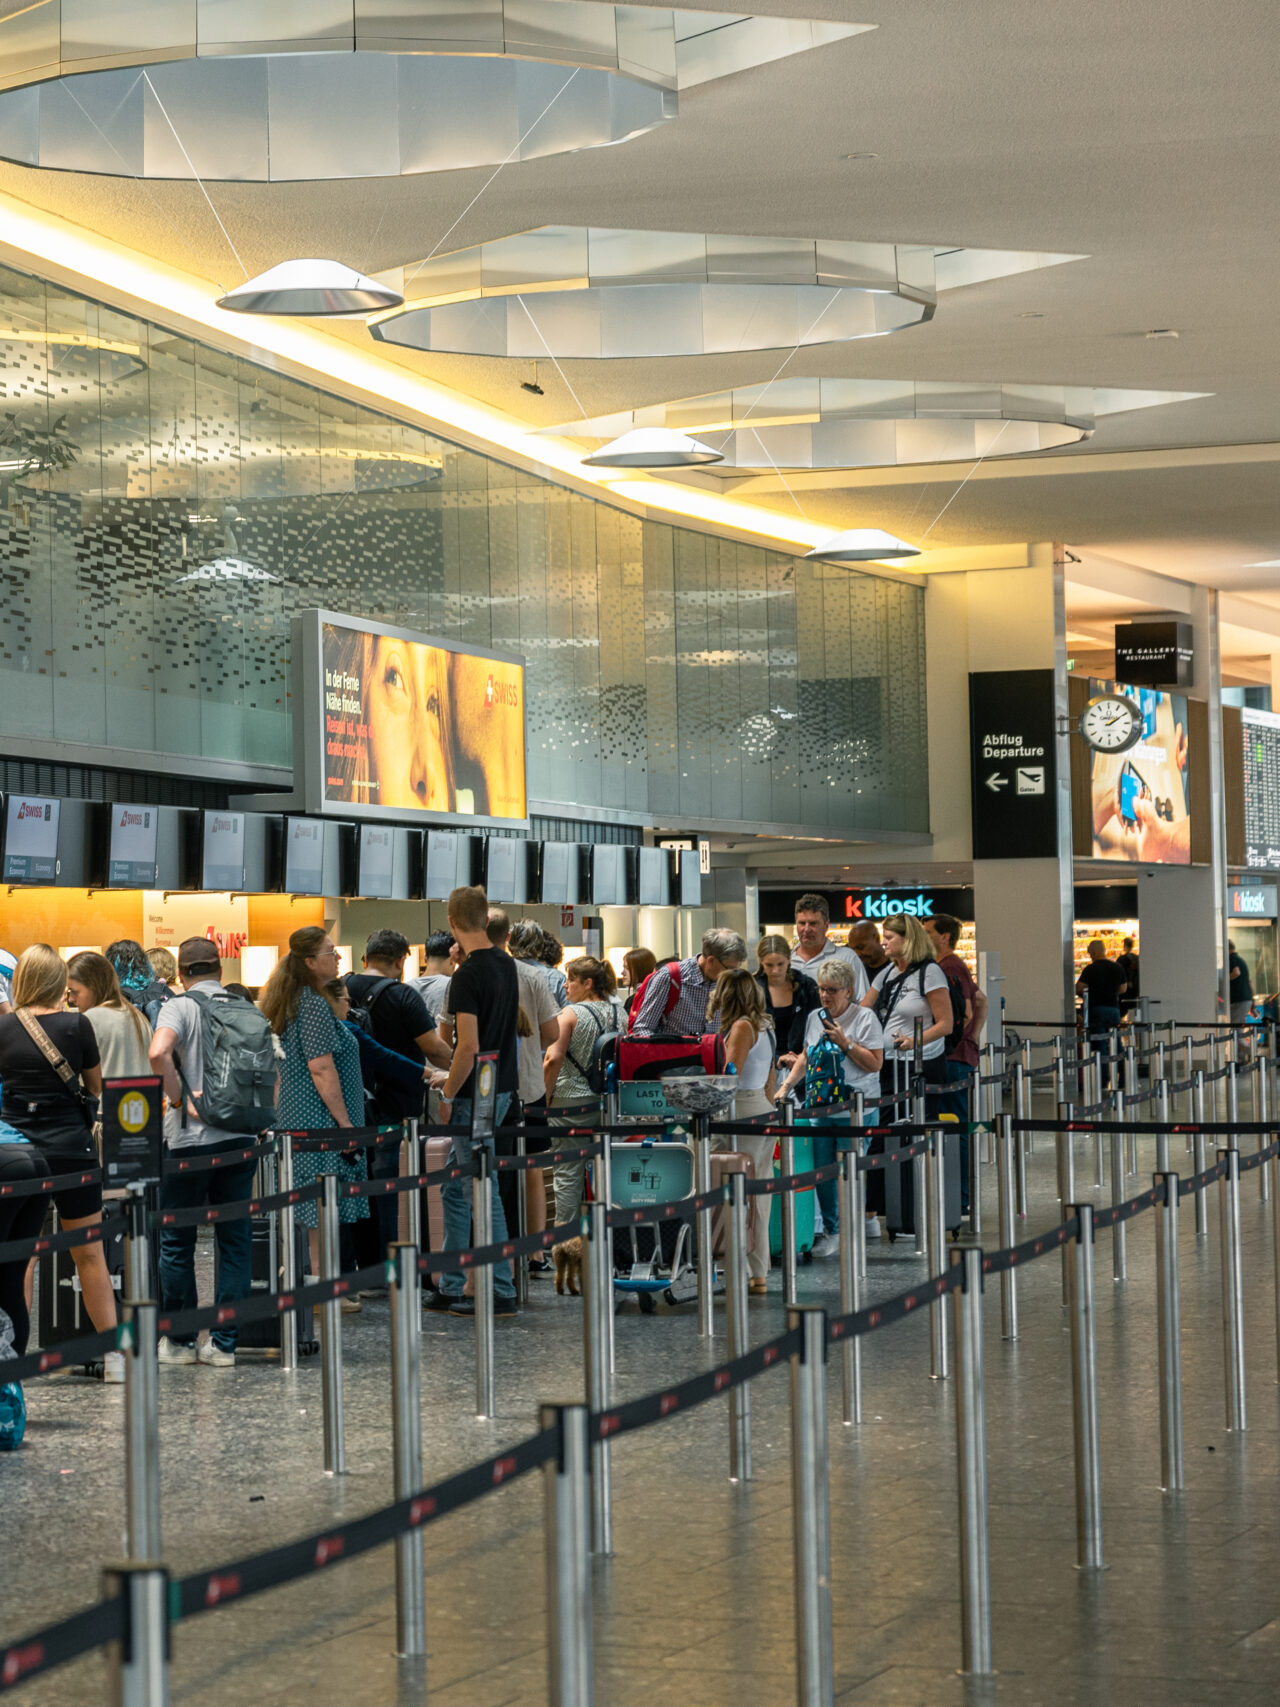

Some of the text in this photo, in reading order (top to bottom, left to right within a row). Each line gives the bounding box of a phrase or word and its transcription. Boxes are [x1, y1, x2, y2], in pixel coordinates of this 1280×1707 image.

[1117, 647, 1133, 655] THE
[1125, 653, 1166, 661] RESTAURANT
[325, 668, 360, 692] In der Ferne
[494, 681, 518, 708] SWISS
[326, 691, 342, 712] Nähe
[983, 734, 1023, 747] Abflug
[983, 746, 1044, 759] Departure
[25, 805, 43, 819] SWISS
[845, 893, 934, 918] k kiosk
[1240, 890, 1265, 912] kiosk
[636, 1090, 660, 1098] LAST
[651, 1100, 663, 1108] TO
